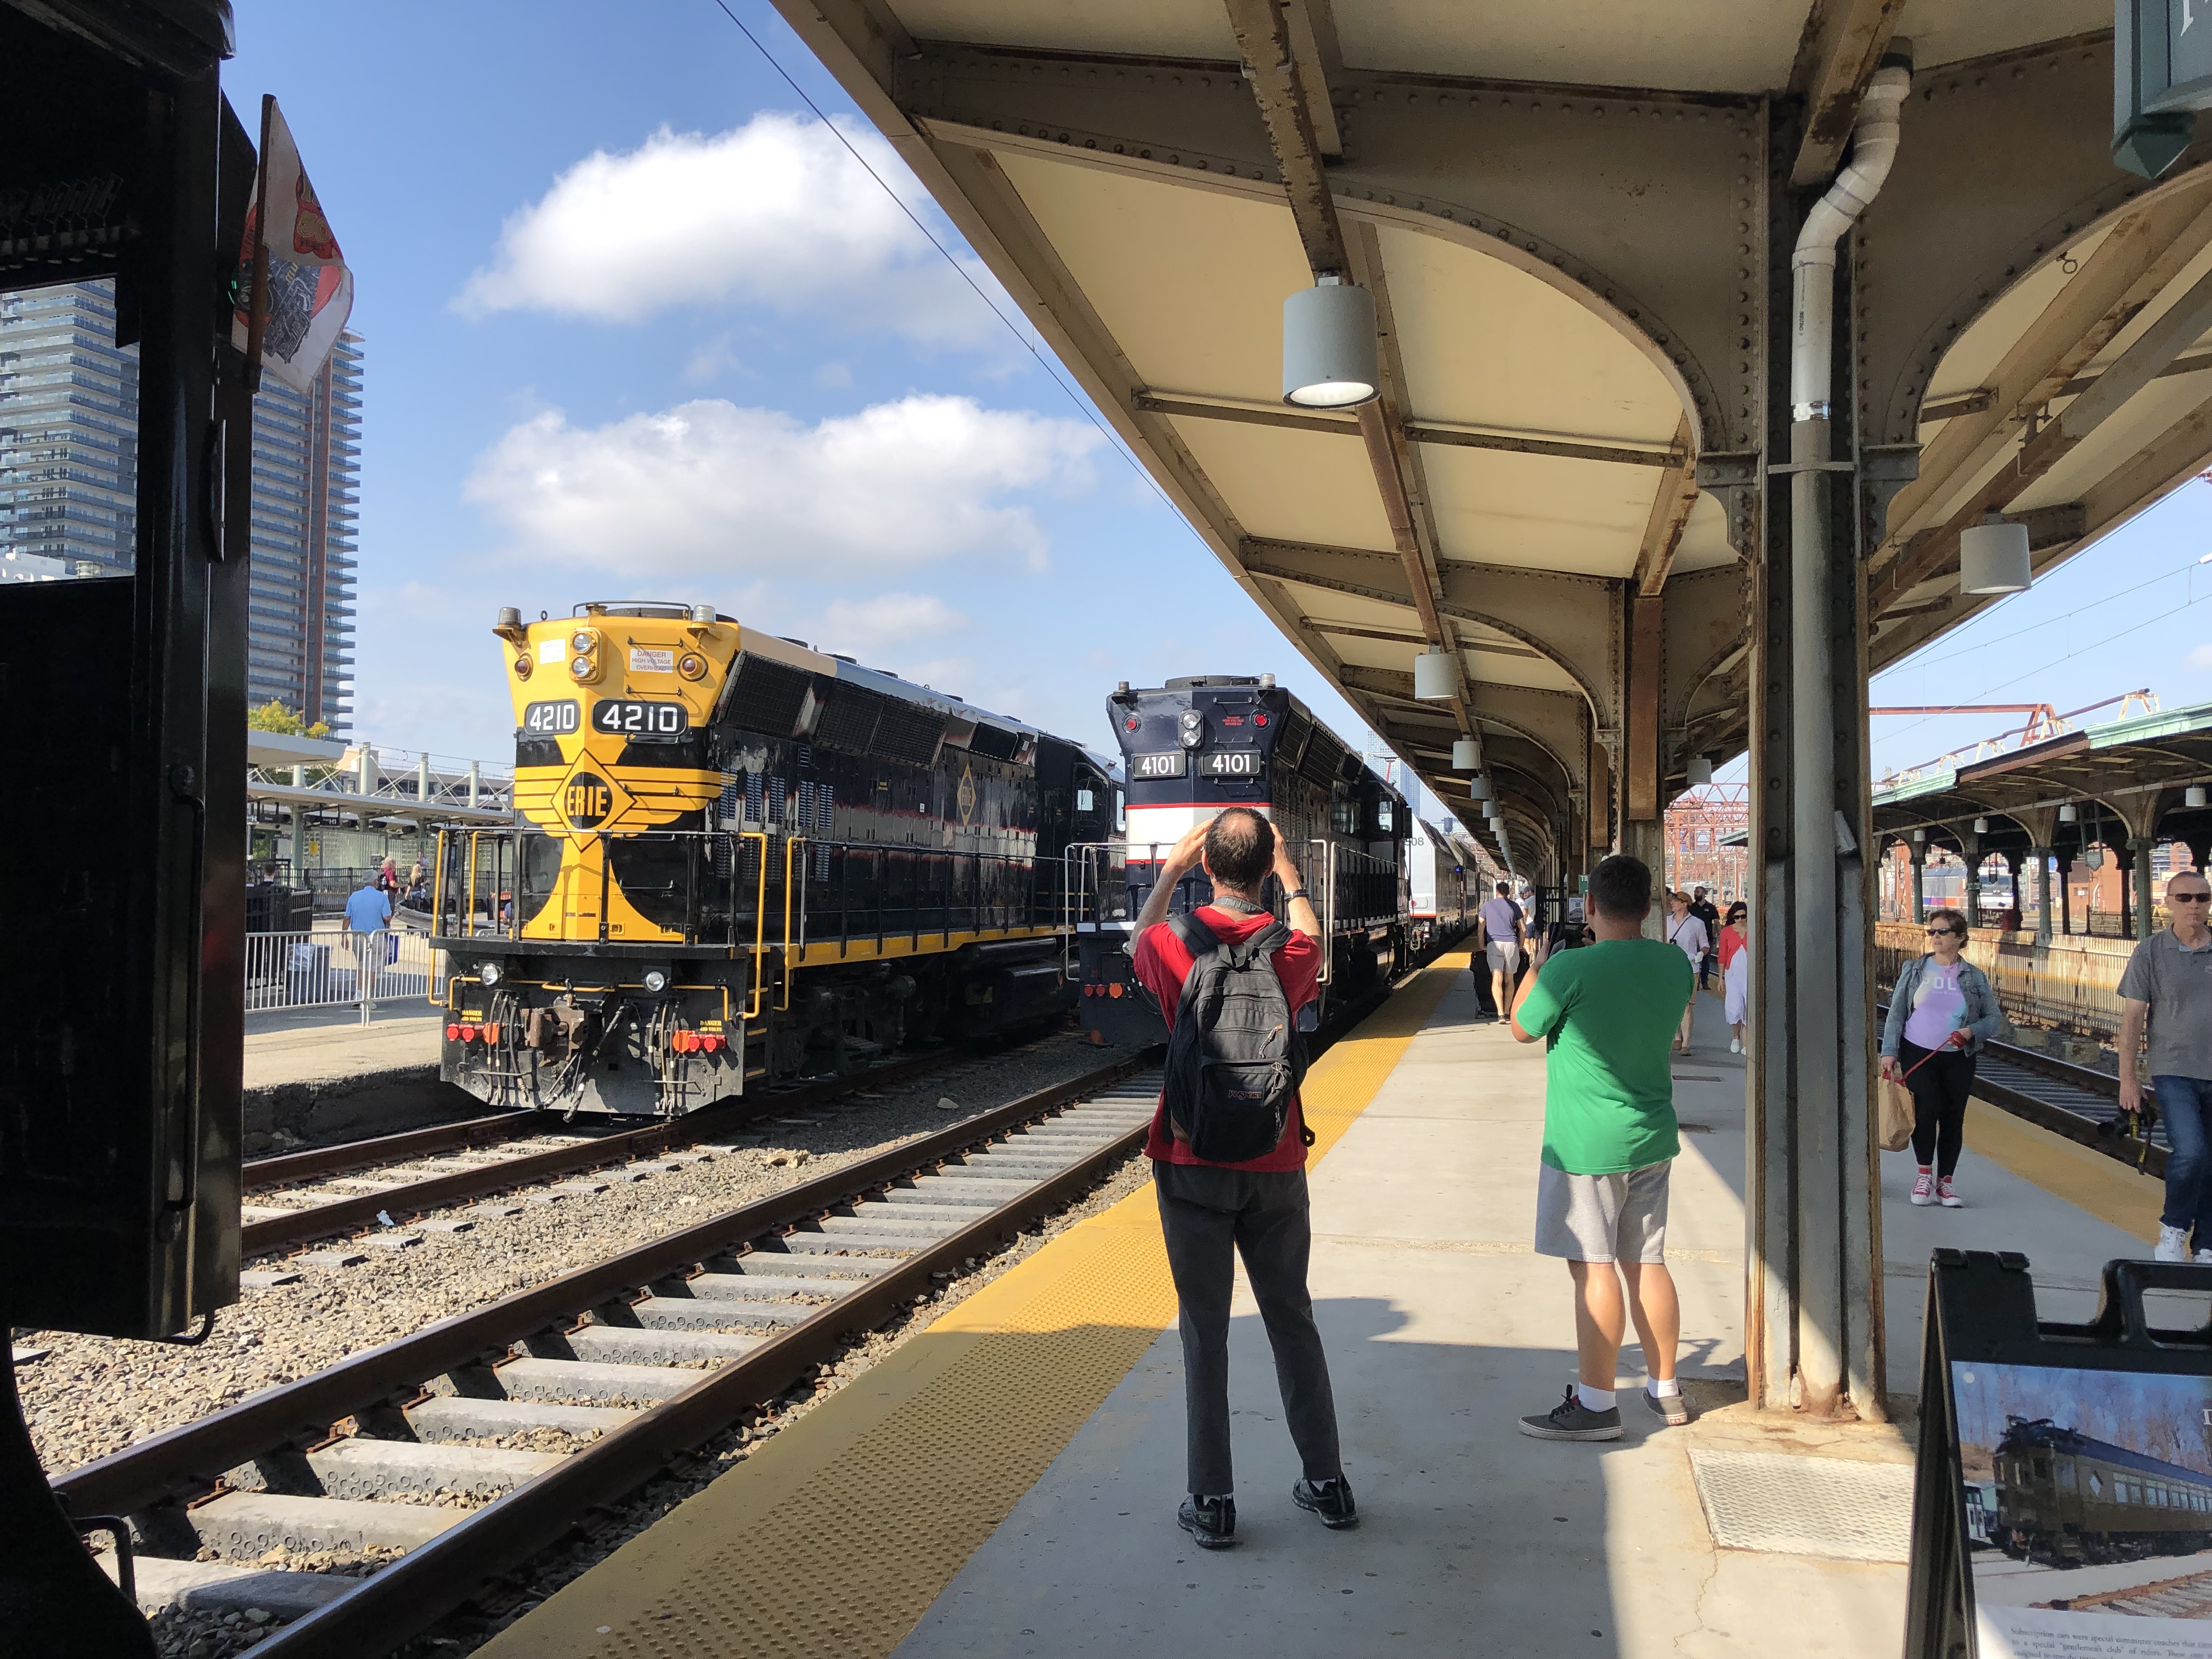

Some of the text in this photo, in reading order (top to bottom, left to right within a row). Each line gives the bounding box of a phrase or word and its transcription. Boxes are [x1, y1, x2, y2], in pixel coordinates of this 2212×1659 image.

[530, 704, 575, 731] 4210
[602, 704, 678, 732] 4210
[1142, 755, 1175, 775] 4101
[1212, 754, 1250, 772] 4101
[567, 786, 607, 817] ERIE
[962, 786, 971, 806] ERIE
[2011, 1628, 2054, 1638] Subscription
[2091, 1635, 2113, 1644] special
[2033, 1641, 2055, 1649] special
